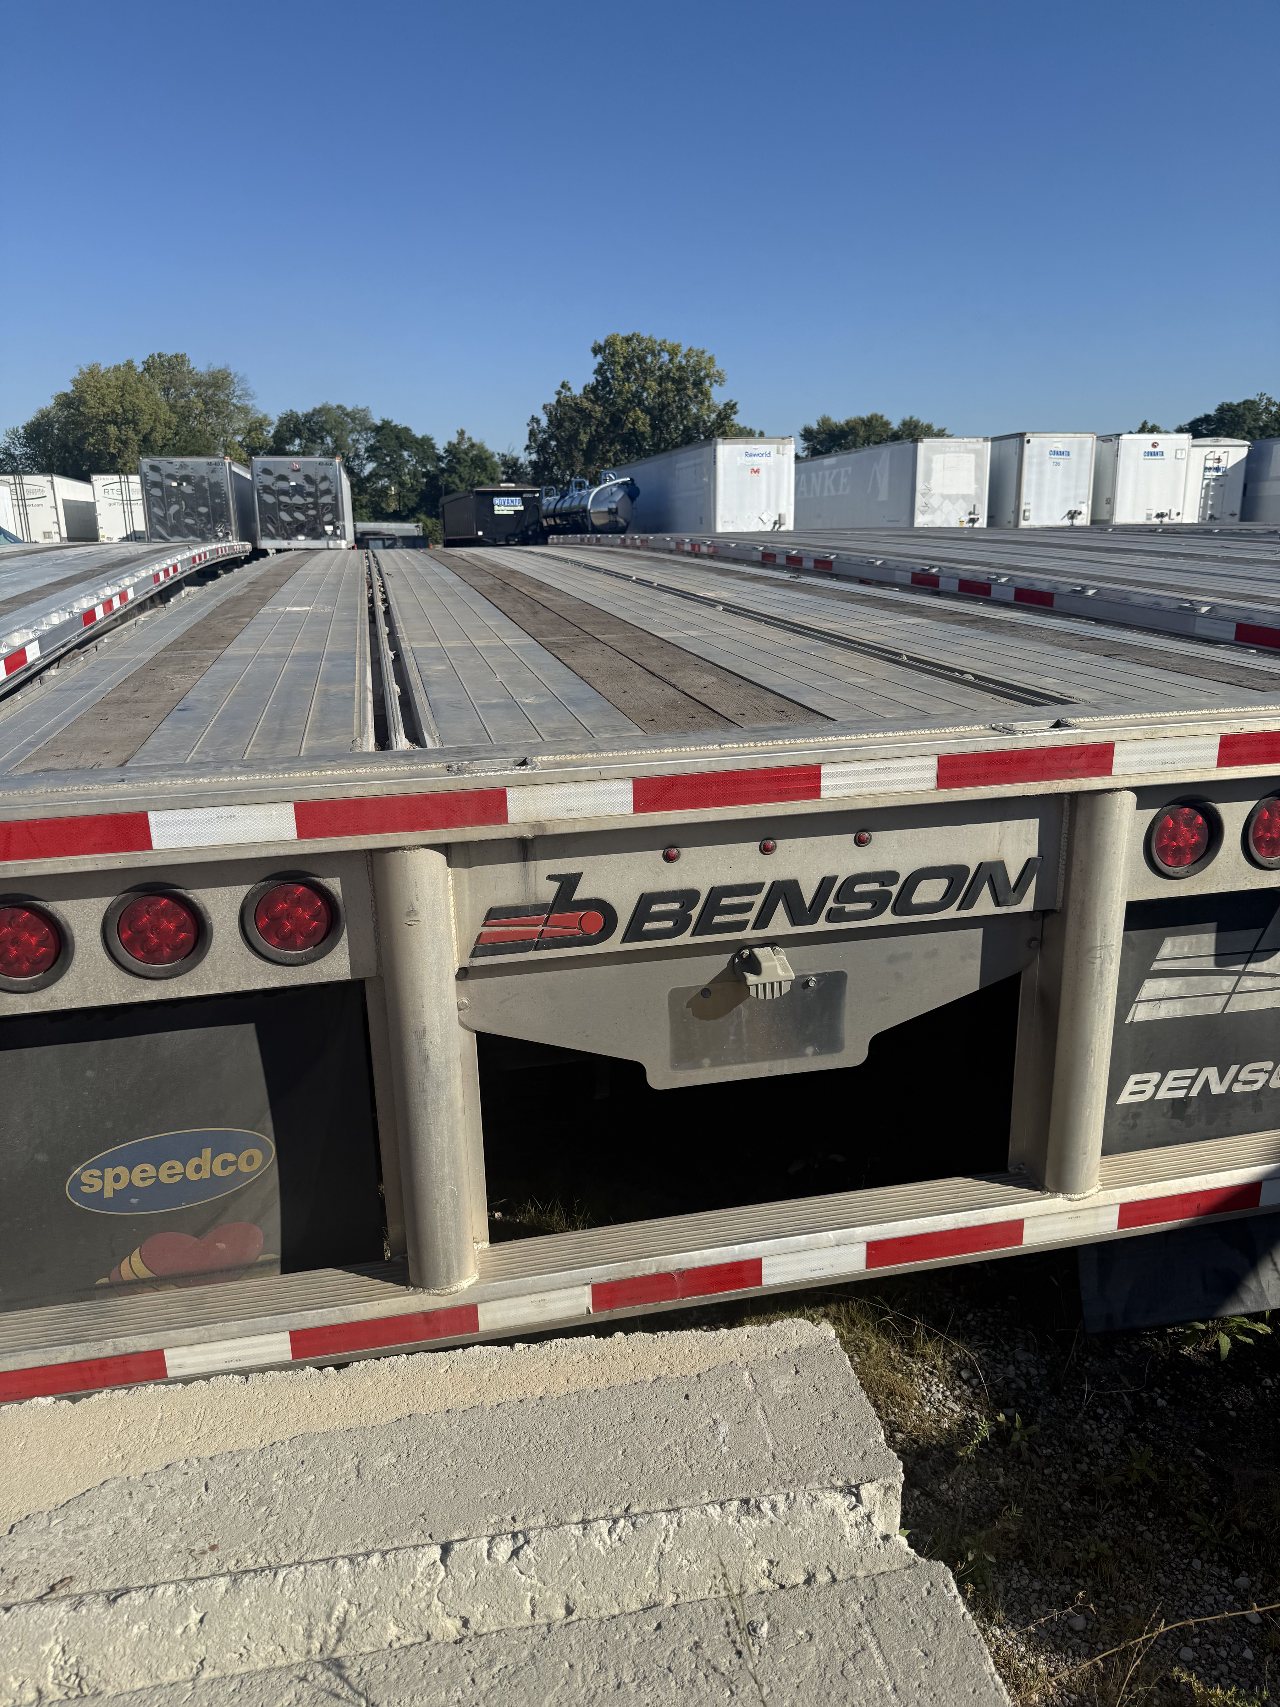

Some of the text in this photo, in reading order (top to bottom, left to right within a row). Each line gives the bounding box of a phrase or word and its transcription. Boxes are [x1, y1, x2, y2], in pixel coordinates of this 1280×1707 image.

[796, 467, 852, 498] ANKE
[620, 857, 1042, 943] BENSON
[1115, 1060, 1280, 1105] BENS
[80, 1147, 263, 1198] speedco
